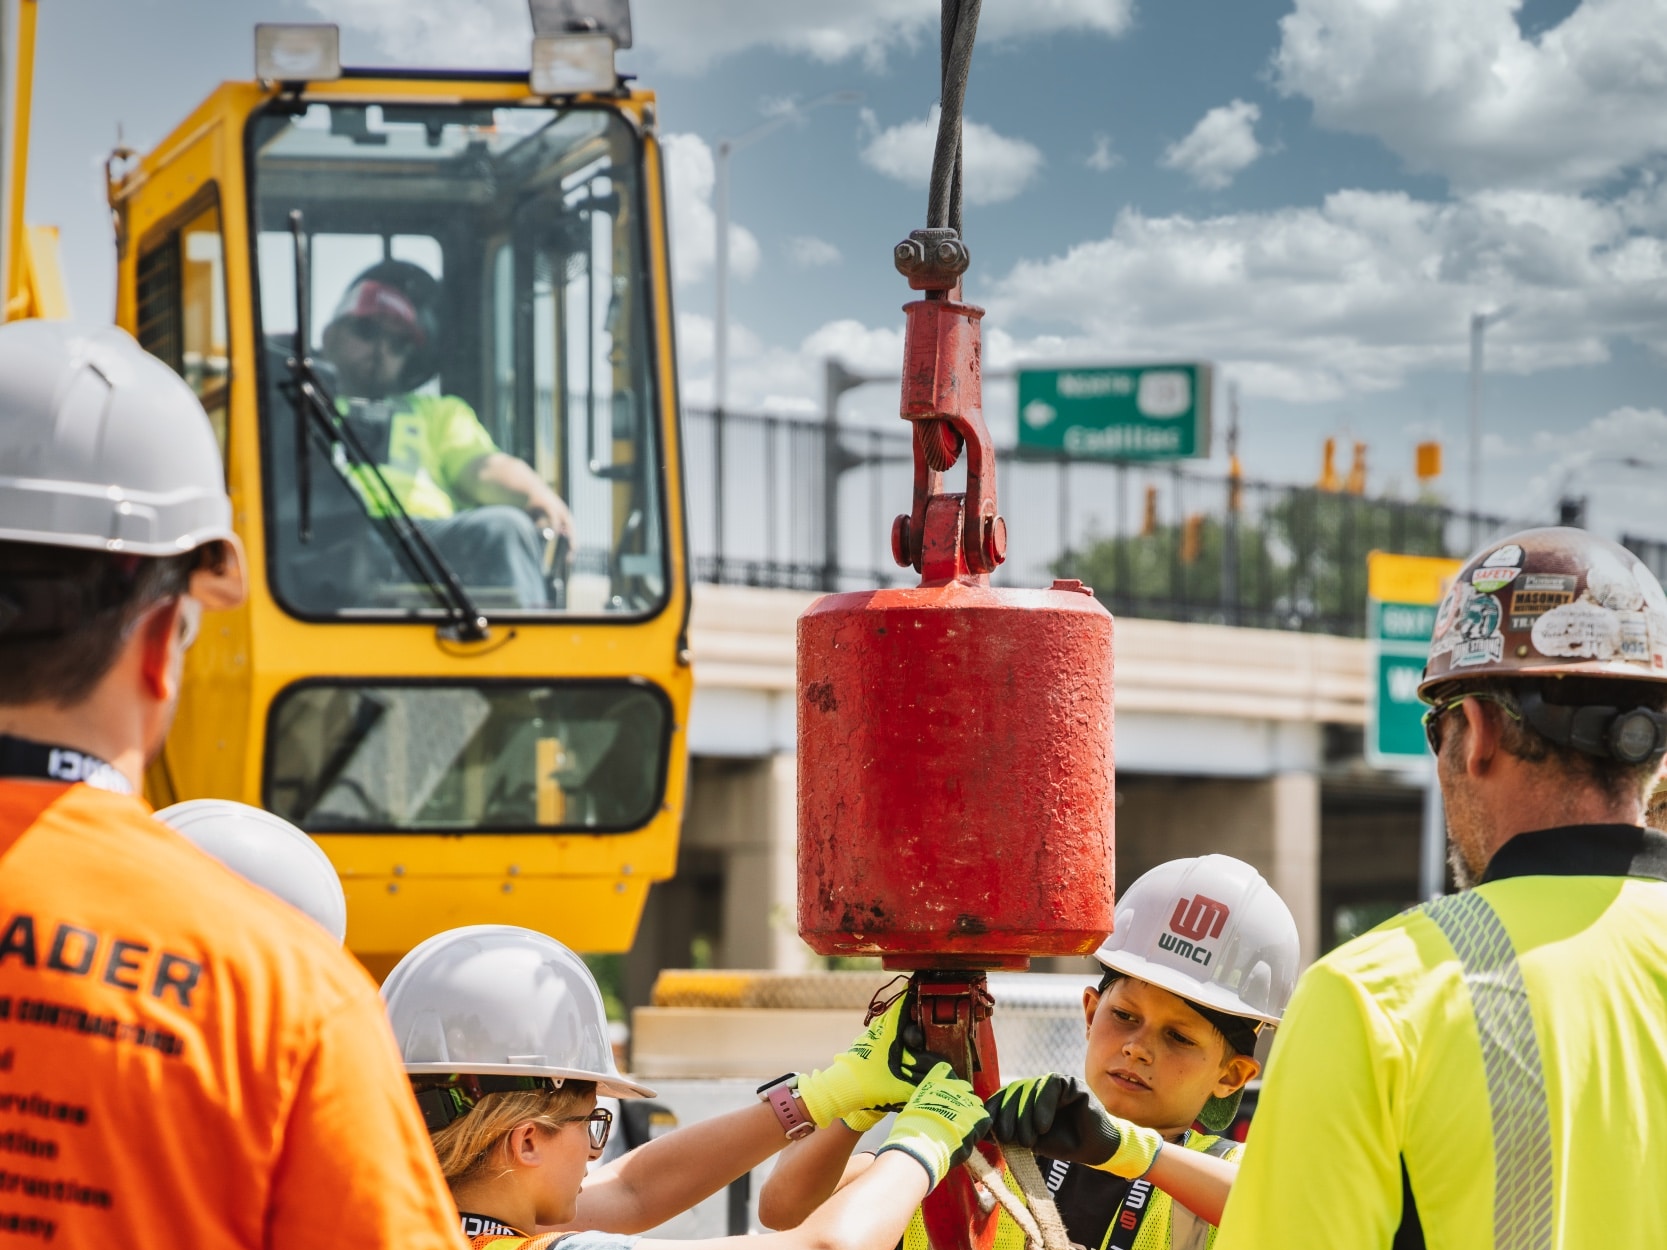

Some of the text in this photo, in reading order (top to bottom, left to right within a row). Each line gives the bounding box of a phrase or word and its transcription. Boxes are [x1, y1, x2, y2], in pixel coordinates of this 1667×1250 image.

[1474, 569, 1517, 580] SAFETY
[1515, 592, 1571, 604] MASONRY
[1158, 932, 1212, 967] WMCI
[0, 915, 203, 1009] ADER
